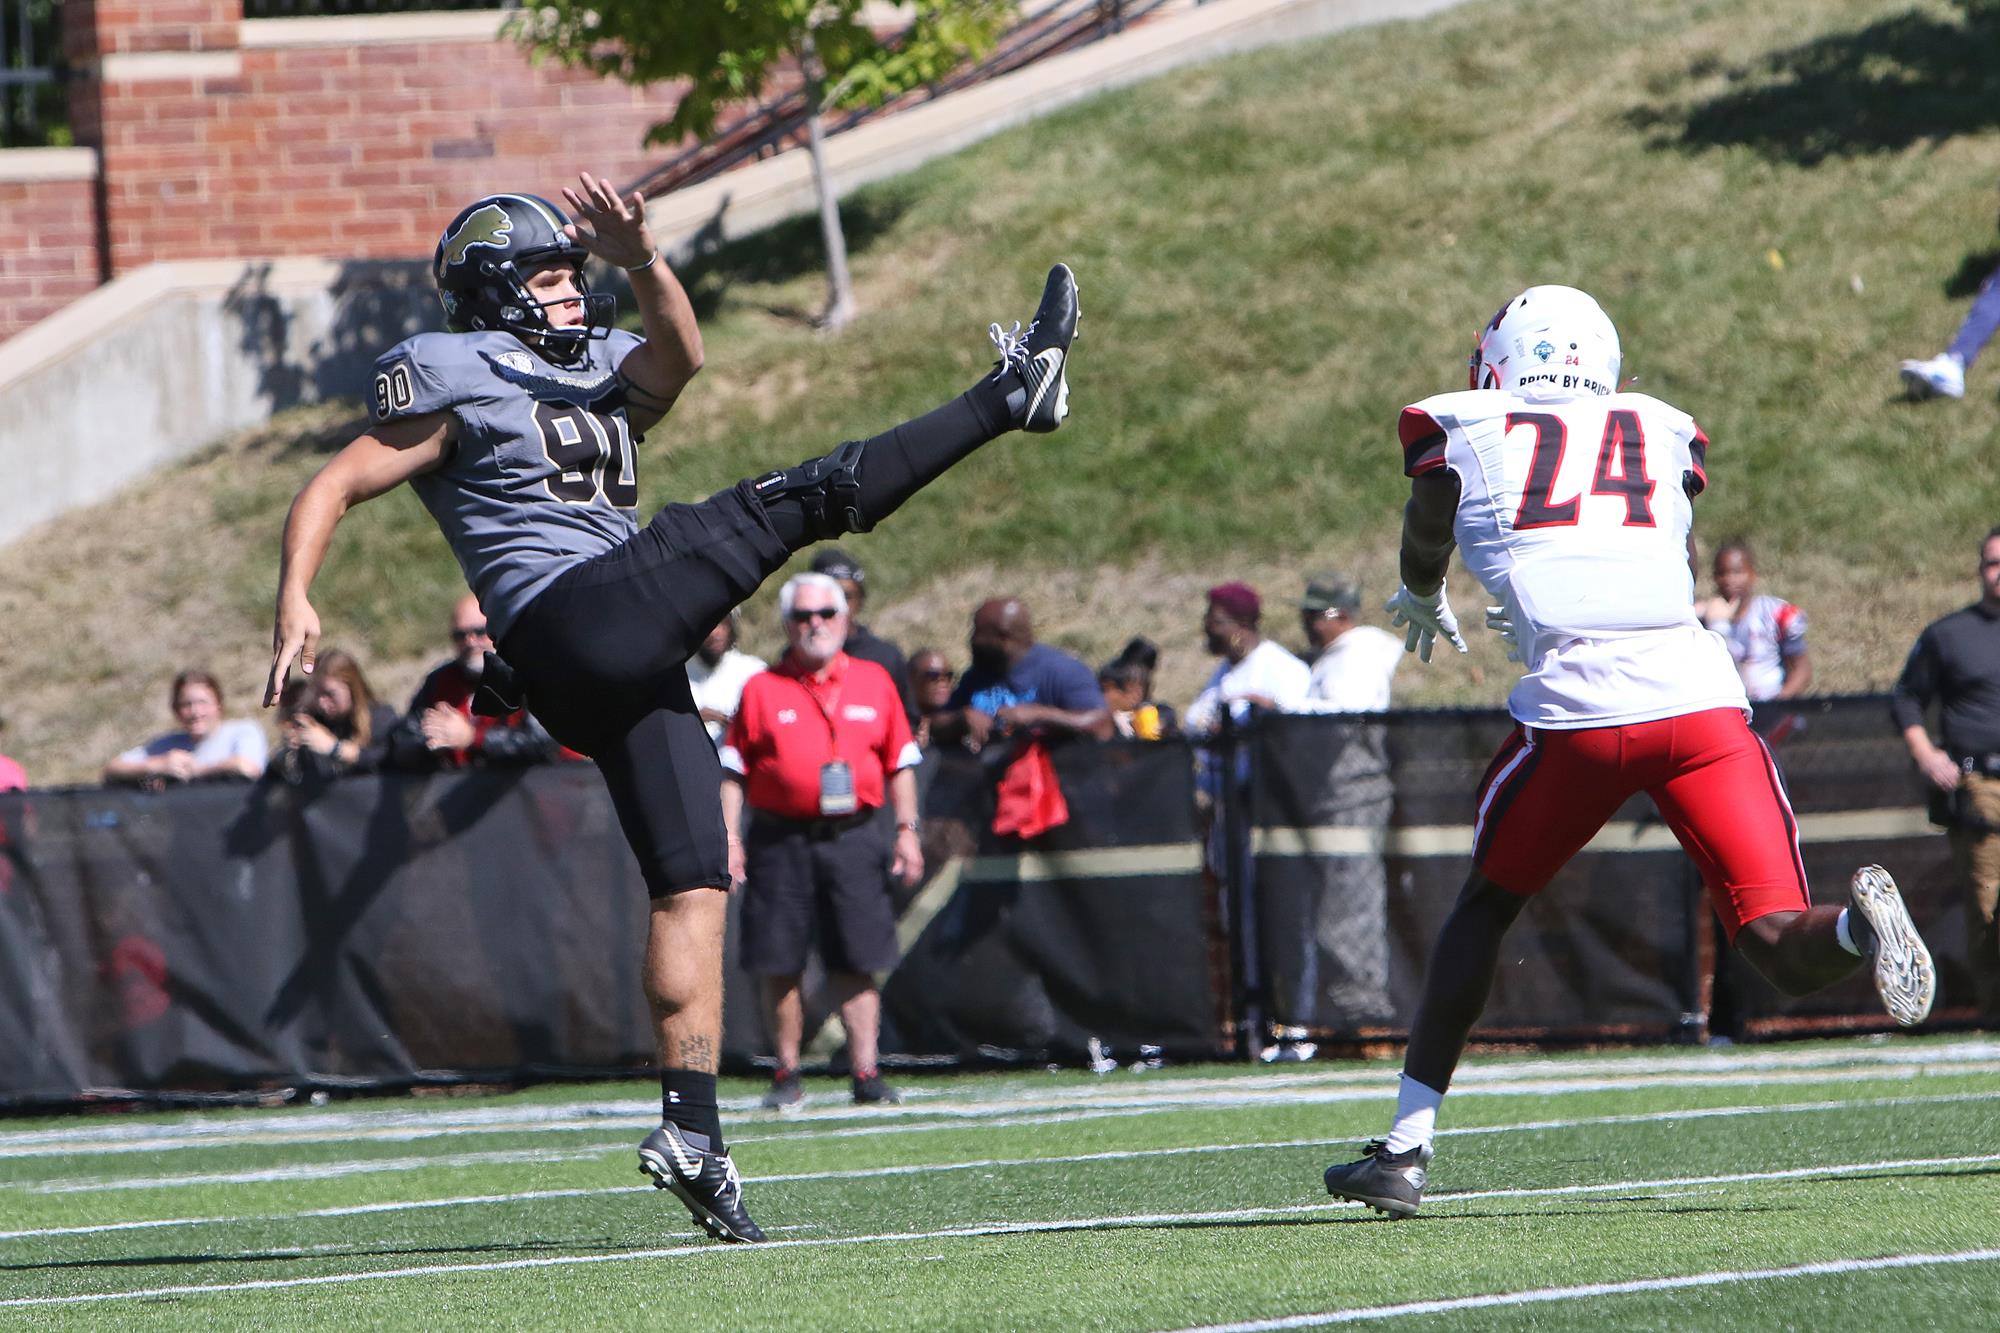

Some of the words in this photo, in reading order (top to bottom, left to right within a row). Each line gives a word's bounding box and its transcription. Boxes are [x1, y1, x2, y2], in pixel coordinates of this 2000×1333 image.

[373, 360, 415, 422] 90
[1562, 375, 1580, 389] BY
[1565, 354, 1580, 366] 24
[530, 400, 638, 509] 90
[1504, 410, 1657, 531] 24
